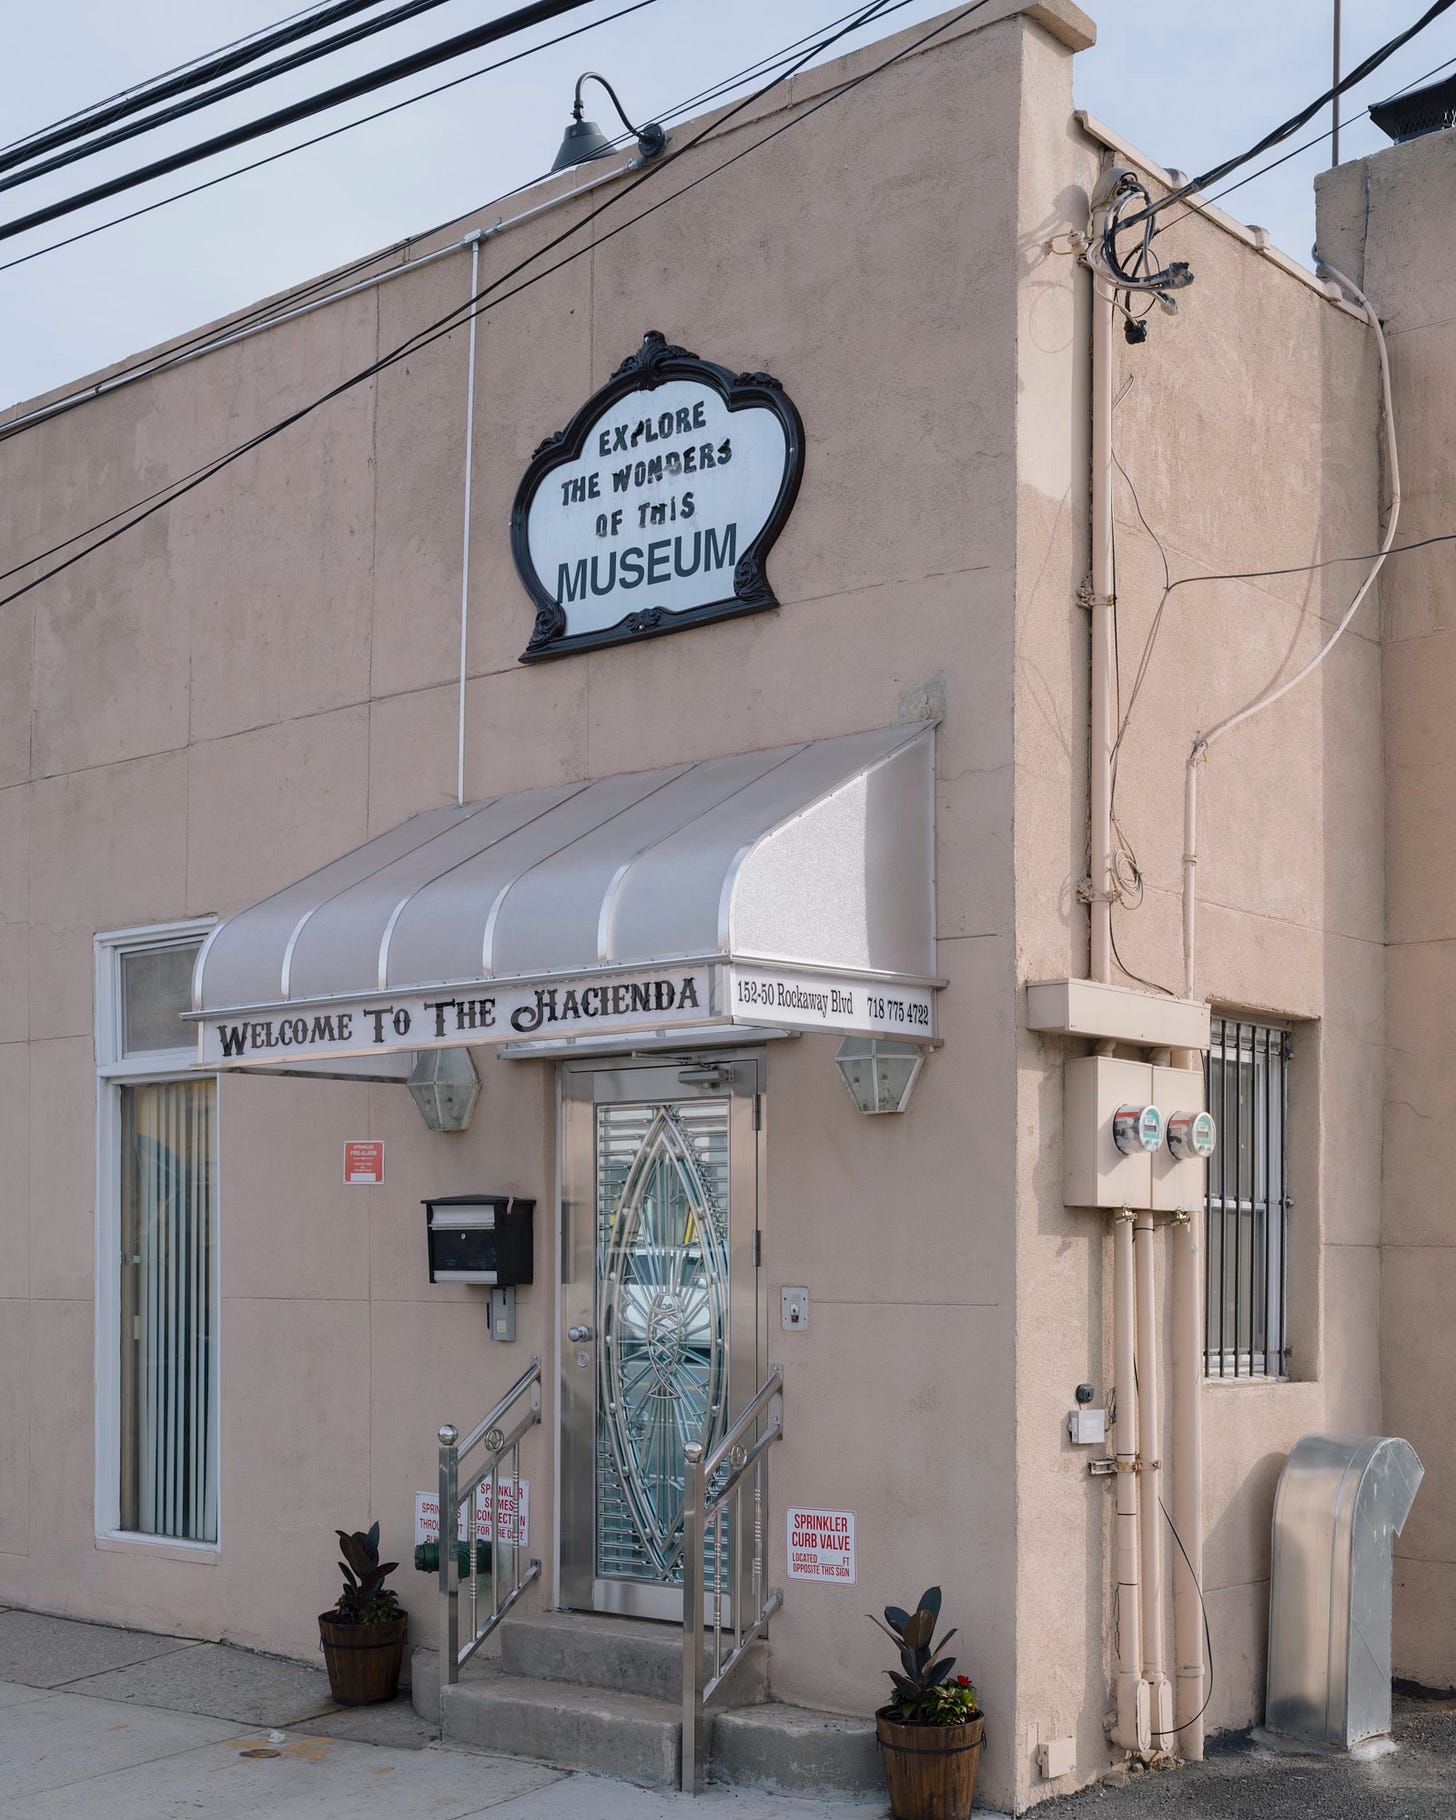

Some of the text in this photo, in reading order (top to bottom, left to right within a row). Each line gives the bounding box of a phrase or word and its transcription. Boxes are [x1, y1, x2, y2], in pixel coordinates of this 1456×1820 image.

[599, 401, 706, 457] EXPLORE
[561, 438, 733, 506] THE WONDERS
[595, 492, 695, 538] OF THIS
[556, 523, 737, 604] MUSEUM
[217, 1013, 352, 1057] WELCOME
[424, 998, 496, 1037] THE
[510, 977, 701, 1033] HACIENDA
[737, 980, 929, 1026] 152-50 Rockaway Blvd 718 775 4722
[480, 1483, 523, 1499] SPNKLR
[477, 1525, 490, 1536] FOR
[794, 1514, 848, 1532] SPRINKLER
[792, 1532, 850, 1551] CURB VALVE
[792, 1553, 817, 1563] LOCATED
[843, 1557, 850, 1566] FT
[793, 1563, 850, 1577] OPPOSITE THIS SIGN
